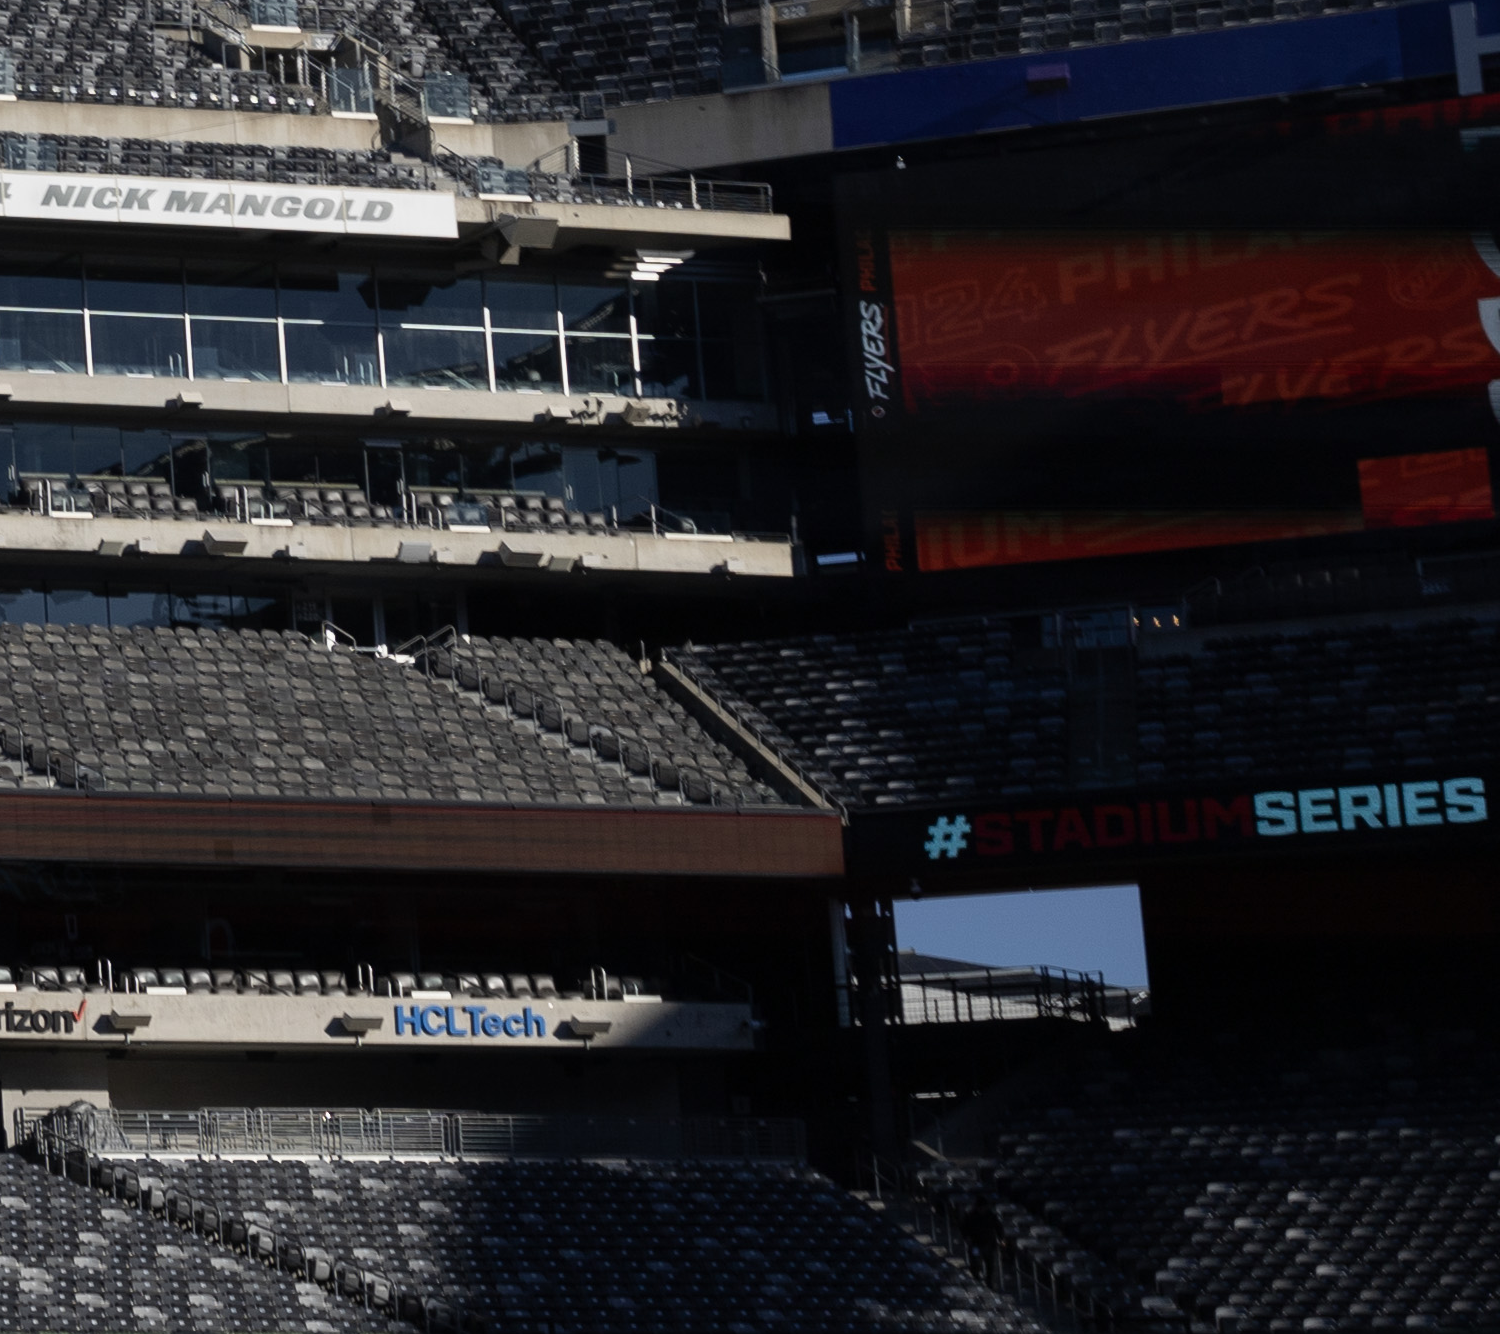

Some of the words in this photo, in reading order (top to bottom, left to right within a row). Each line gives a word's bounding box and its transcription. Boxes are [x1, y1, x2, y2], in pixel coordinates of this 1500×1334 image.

[40, 183, 158, 211] NICK
[162, 189, 395, 223] MANGOLD
[859, 300, 896, 399] FLYERS
[1045, 273, 1362, 387] FLYERS
[923, 776, 1489, 861] #STADIUMSERIES
[393, 1004, 547, 1039] HCLTech
